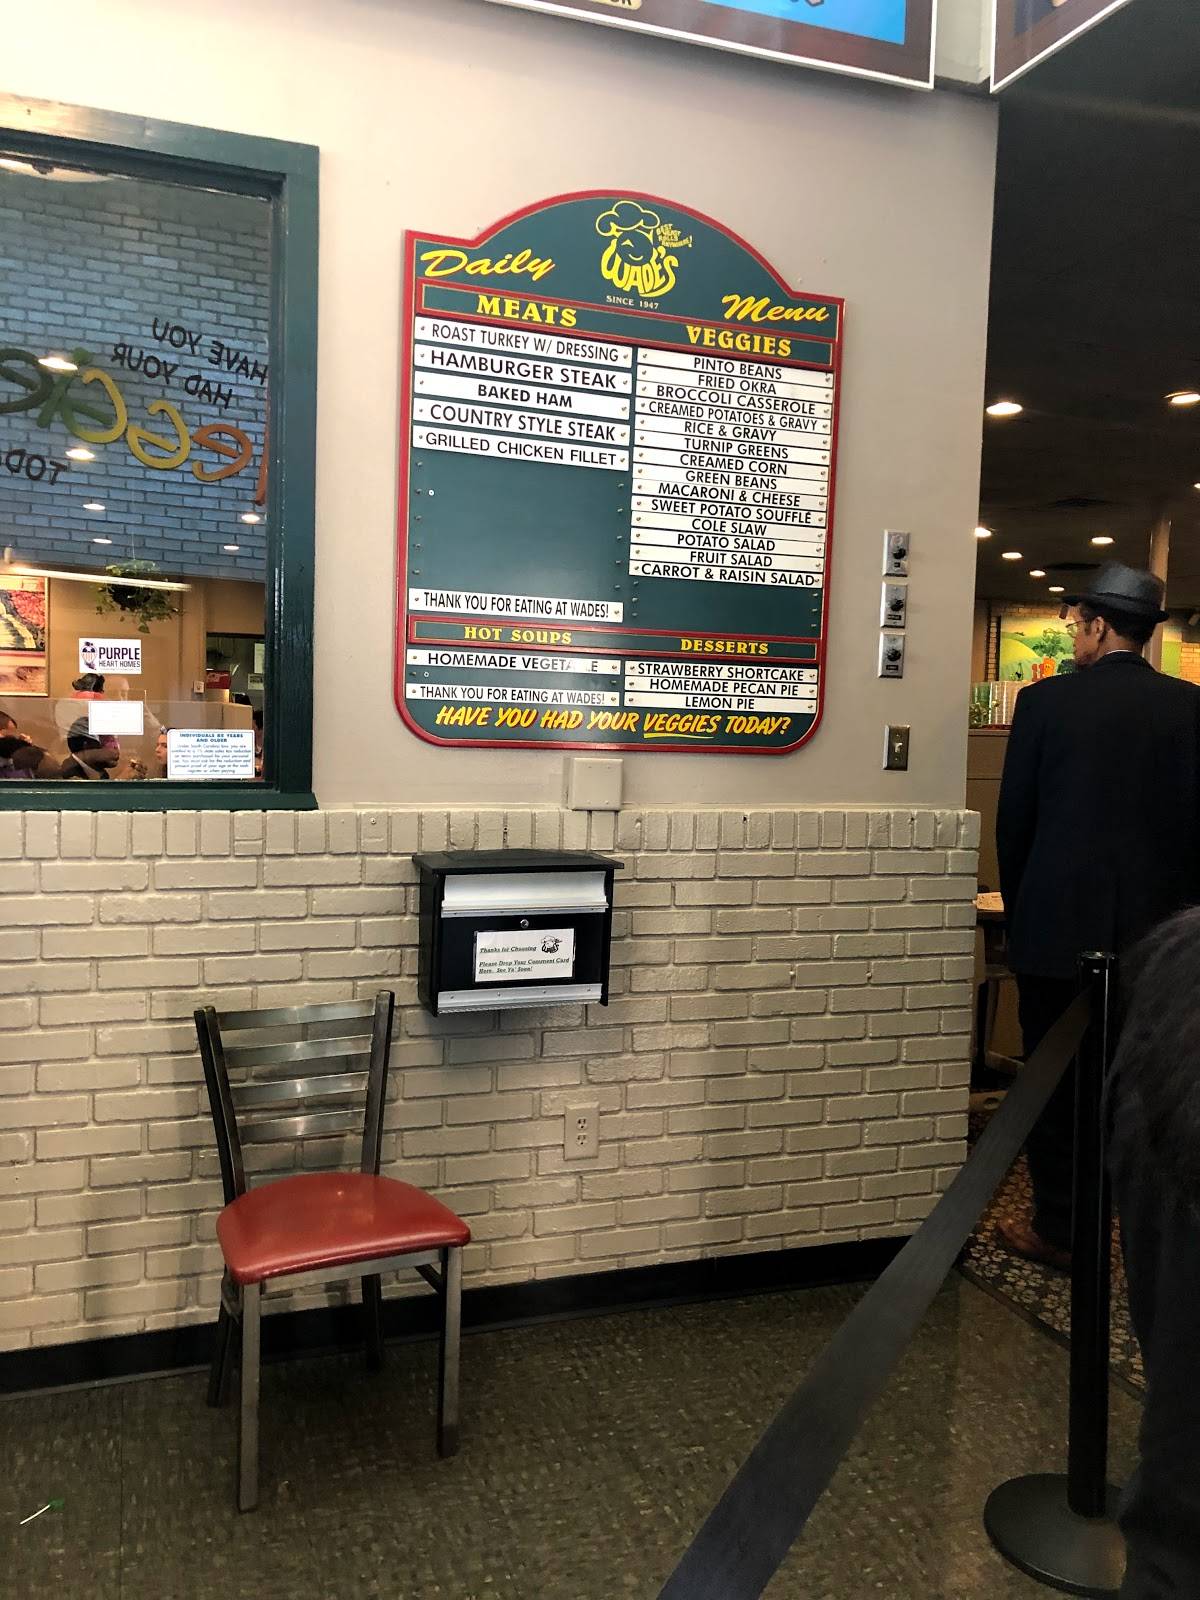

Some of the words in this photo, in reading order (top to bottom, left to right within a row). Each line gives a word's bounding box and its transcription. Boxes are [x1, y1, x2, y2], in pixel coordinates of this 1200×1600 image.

[420, 249, 556, 280] Daily
[476, 295, 577, 327] MEATS
[606, 296, 634, 306] SINCE
[639, 300, 660, 309] 1947
[721, 294, 829, 322] Menu
[432, 324, 476, 345] ROAST
[480, 331, 529, 350] TURKEY
[533, 336, 553, 354] W/
[557, 340, 619, 362] DRESSING
[686, 325, 792, 357] VEGGIES
[431, 350, 554, 380] HAMBURGER
[561, 369, 616, 389] STEAK
[694, 357, 736, 376] PINTO
[739, 364, 782, 380] BEANS
[698, 375, 737, 391] FRIED
[740, 380, 777, 395] OKRA
[478, 384, 531, 404] BAKED
[535, 391, 572, 408] HAM
[656, 386, 733, 405] BROCCOLI
[736, 396, 816, 414] CASSEROLE
[430, 404, 512, 429] COUNTRY
[518, 415, 563, 435] STYLE
[568, 422, 615, 441] STEAK
[649, 402, 704, 419] CREAMED
[708, 408, 765, 425] POTATOES
[768, 414, 776, 426] &
[780, 416, 817, 430] GRAVY
[684, 421, 714, 437] RICE
[718, 425, 726, 437] &
[730, 426, 777, 442] GRAVY
[426, 432, 490, 453] GRILLED
[497, 441, 564, 461] CHICKEN
[571, 450, 616, 465] FILLET
[685, 438, 733, 455] TURNIP
[736, 444, 788, 459] GREENS
[680, 455, 744, 472] CREAMED
[748, 462, 787, 476] CORN
[685, 471, 730, 486] GREEN
[735, 476, 777, 490] BEANS
[658, 483, 735, 501] MACARONI
[739, 490, 748, 502] &
[752, 491, 800, 507] CHEESE
[651, 499, 696, 514] SWEET
[700, 504, 752, 520] POTATO
[692, 519, 725, 532] COLE
[729, 522, 767, 535] SLAW
[677, 534, 729, 548] POTATO
[733, 537, 775, 552] SALAD
[690, 551, 728, 564] FRUIT
[731, 554, 772, 567] SALAD
[641, 564, 700, 579] CARROT
[704, 567, 714, 579] &
[719, 569, 766, 583] RAISIN
[770, 572, 815, 586] SALAD
[424, 592, 462, 609] THANK
[465, 595, 488, 611] YOU
[491, 597, 511, 612] FOR
[514, 598, 552, 614] EATING
[555, 602, 568, 616] AT
[570, 602, 609, 618] WADES!
[464, 627, 502, 640] HOT
[511, 629, 572, 644] SOUPS
[98, 647, 140, 660] PURPLE
[681, 639, 769, 654] DESSERTS
[428, 653, 517, 668] HOMEMADE
[638, 663, 723, 678] STRAWBERRY
[727, 666, 803, 681] SHORTCAKE
[420, 686, 456, 698] THANK
[461, 688, 484, 700] YOU
[487, 688, 507, 700] FOR
[511, 690, 548, 702] EATING
[552, 692, 564, 703] AT
[566, 692, 605, 704] WADES!
[650, 678, 730, 693] HOMEMADE
[733, 682, 776, 694] PECAN
[780, 684, 798, 695] PIE
[685, 696, 733, 708] LEMON
[736, 698, 755, 710] PIE
[436, 705, 492, 726] HAVE
[494, 707, 538, 728] YOU
[540, 710, 584, 729] HAD
[586, 710, 638, 732] YOUR
[643, 713, 720, 733] VEGGIES
[724, 717, 791, 736] TODAY?
